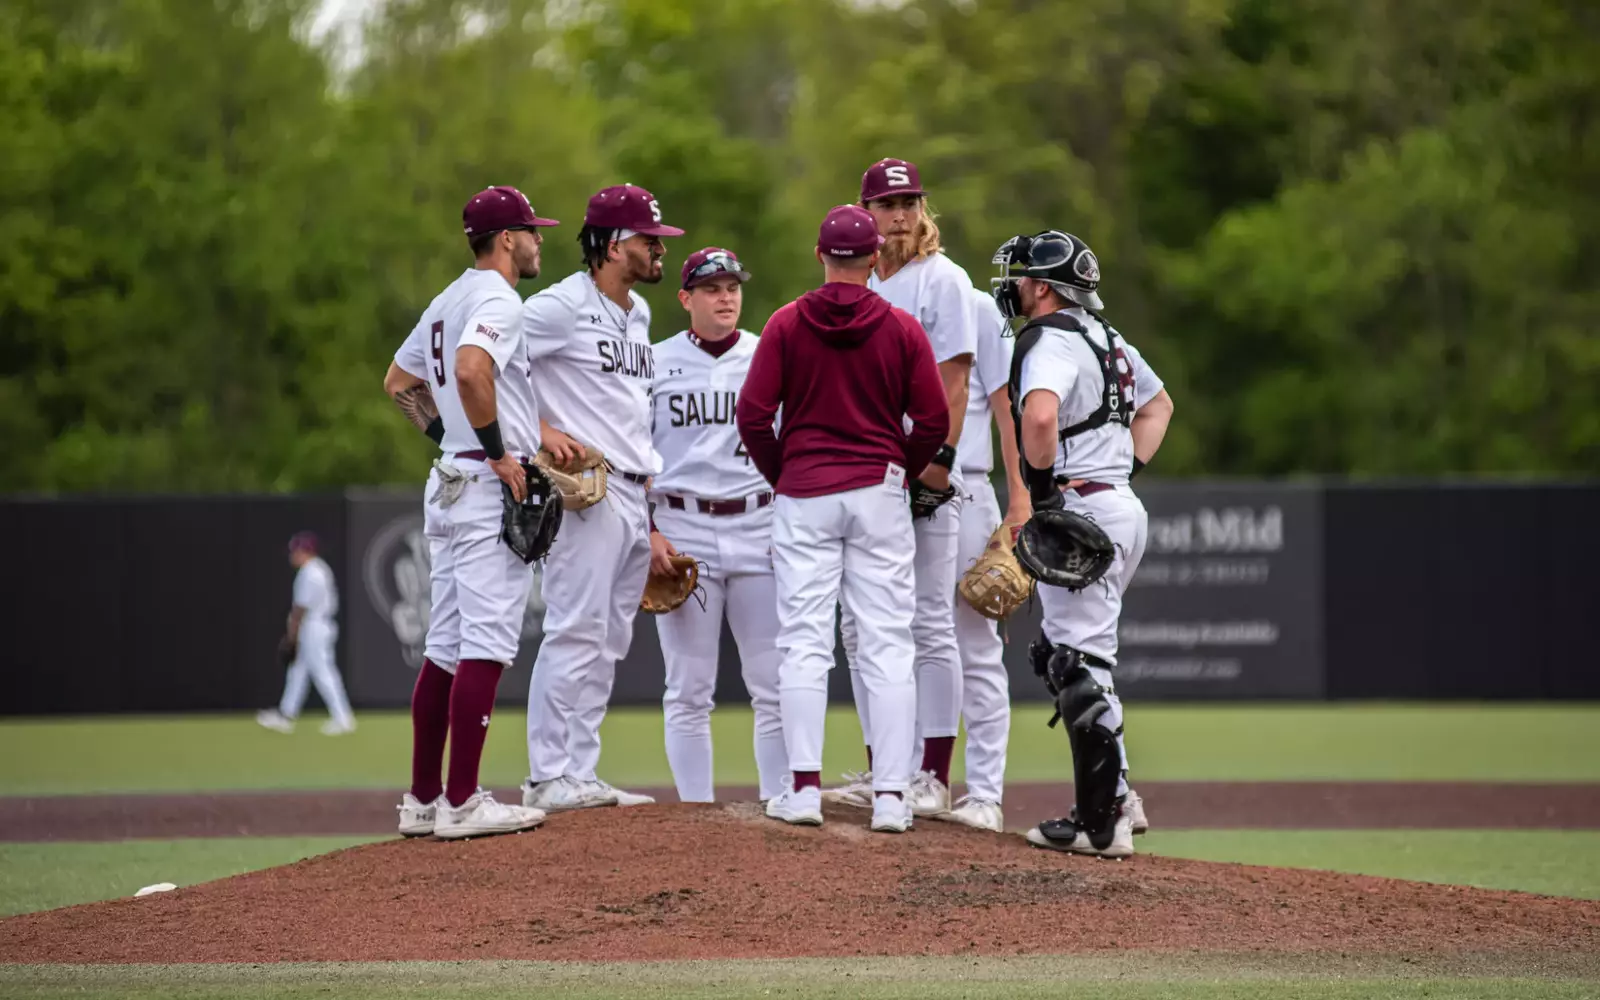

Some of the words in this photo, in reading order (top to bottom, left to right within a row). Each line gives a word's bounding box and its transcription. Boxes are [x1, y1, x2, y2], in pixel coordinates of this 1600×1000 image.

[885, 166, 911, 187] S
[649, 199, 662, 222] S
[830, 248, 855, 256] SALUKIS
[431, 320, 446, 388] 9
